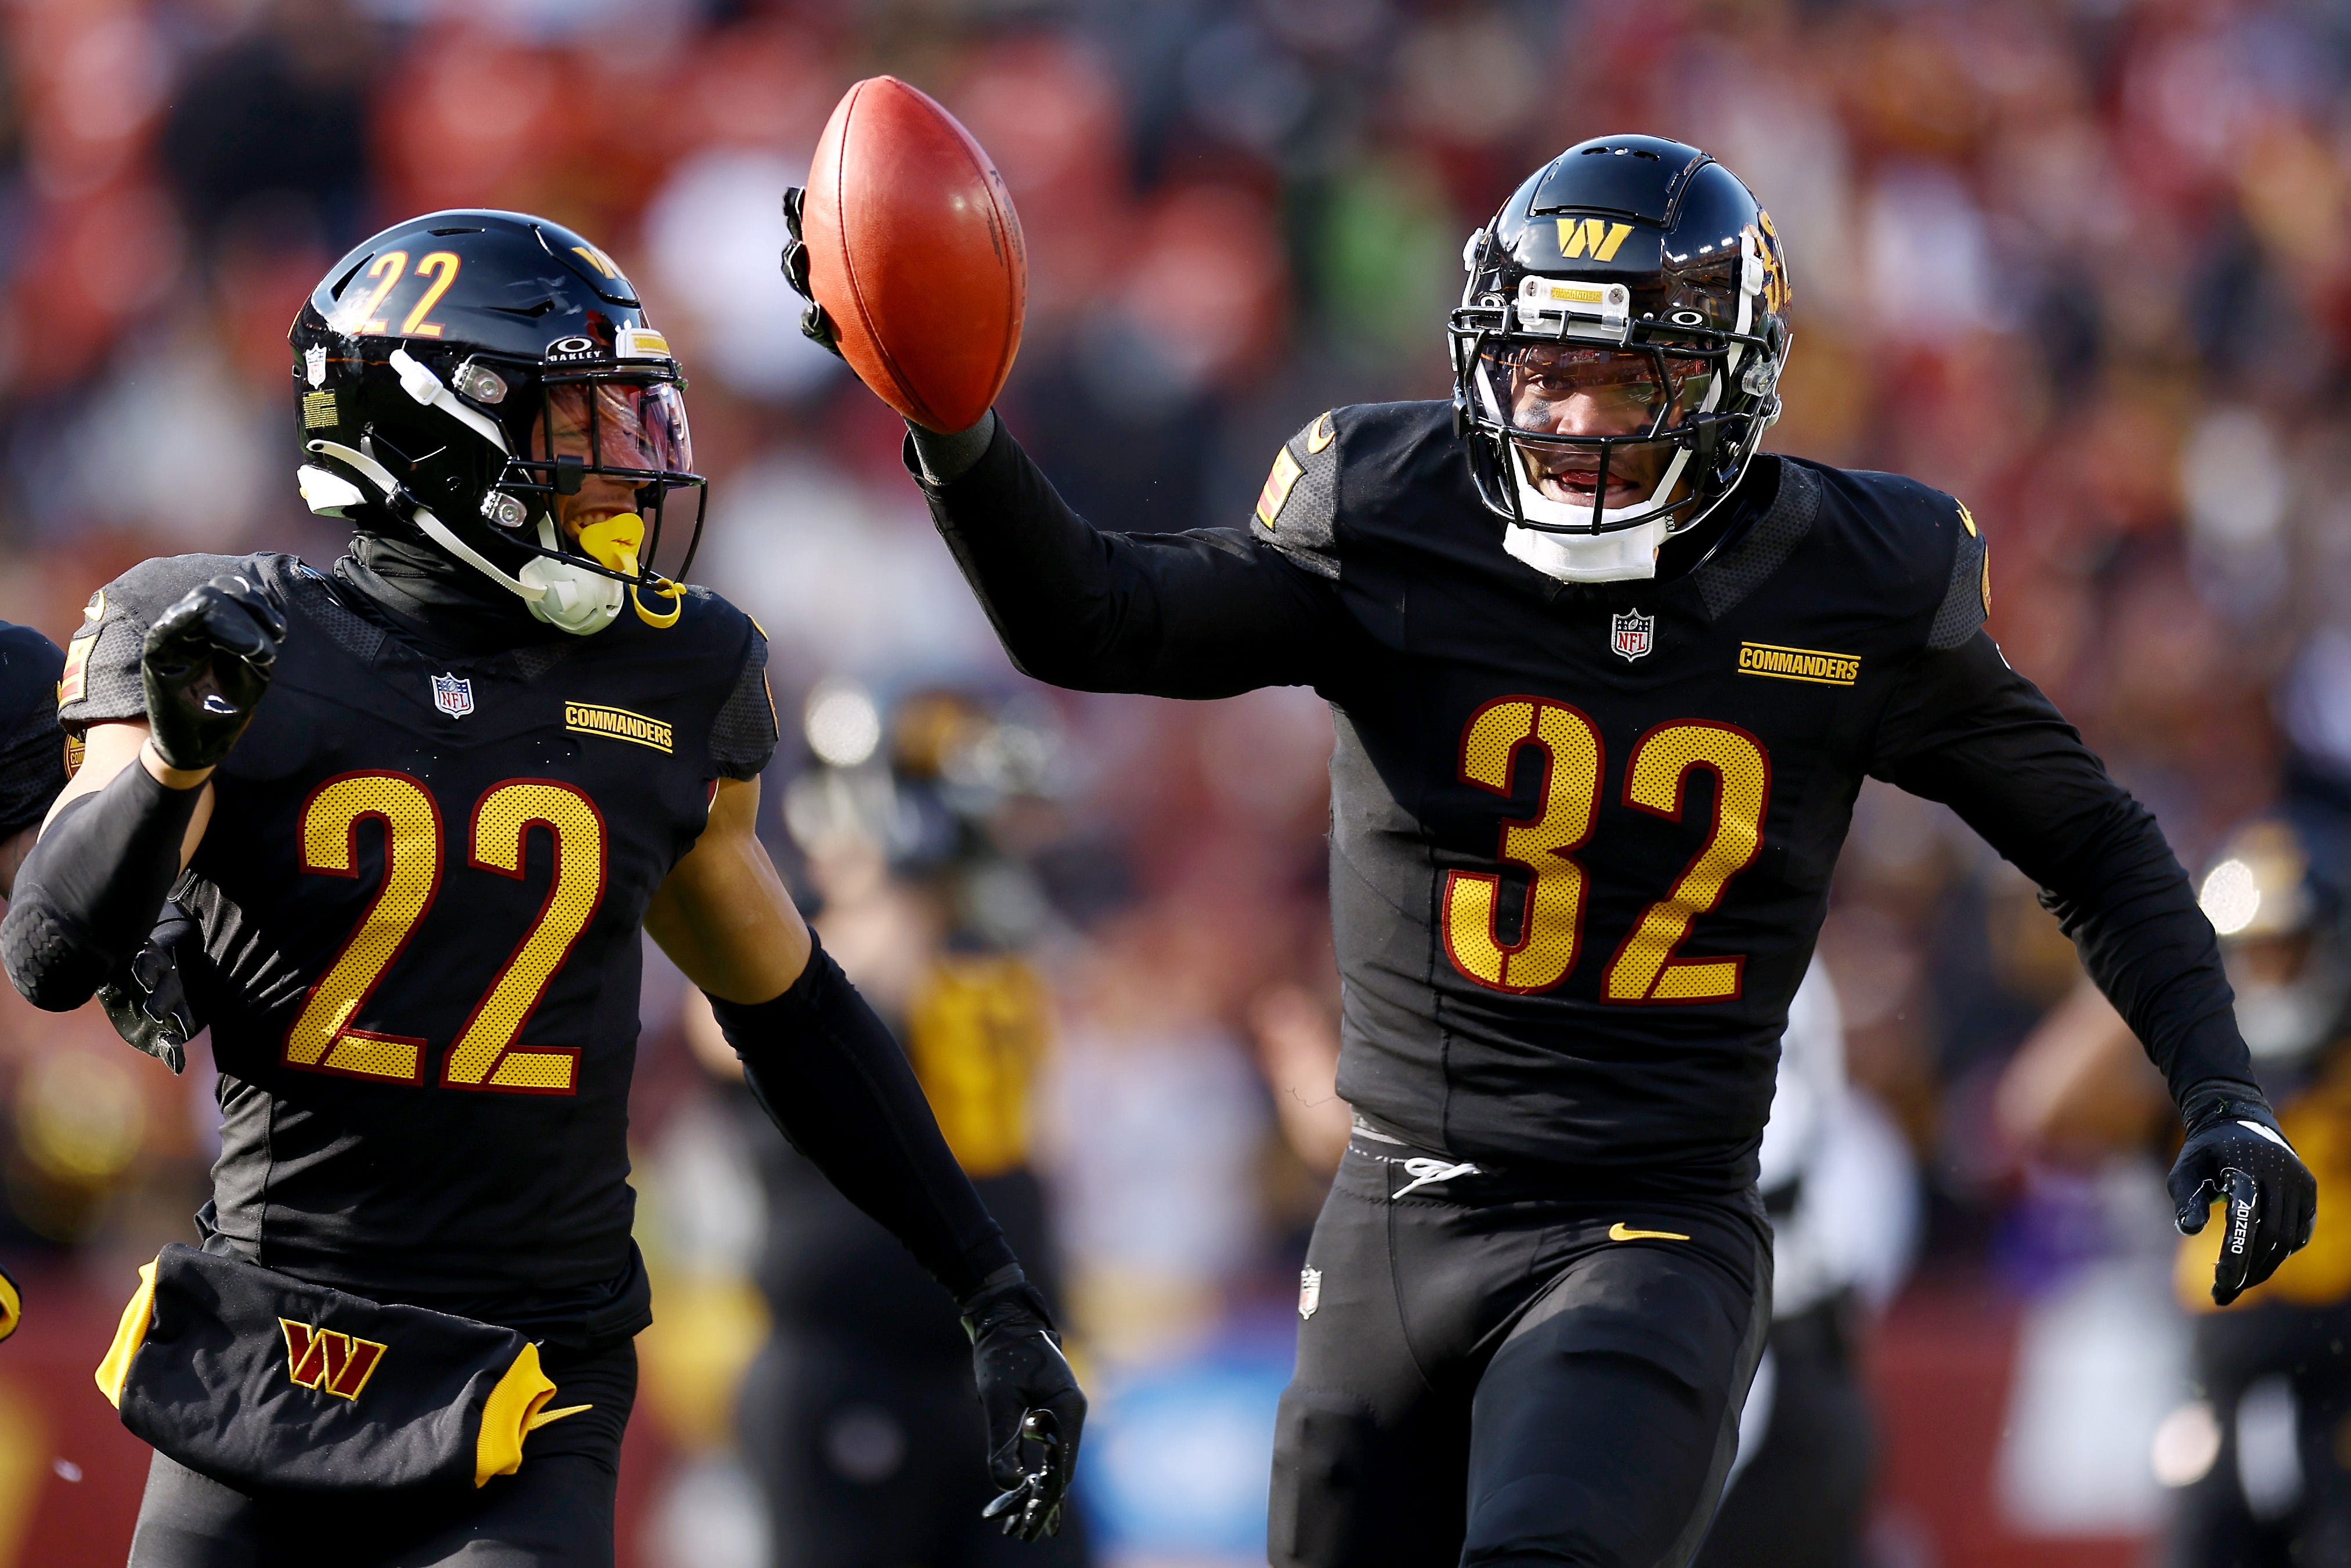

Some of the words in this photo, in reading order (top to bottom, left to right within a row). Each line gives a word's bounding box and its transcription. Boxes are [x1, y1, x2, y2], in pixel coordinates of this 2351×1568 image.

[1557, 218, 1635, 263] W
[351, 250, 462, 341] 22
[1551, 287, 1603, 302] COMMANDERS
[548, 351, 601, 362] OAKLEY
[1618, 632, 1646, 652] NFL
[1739, 648, 1859, 680] COMMANDERS
[441, 692, 468, 709] NFL
[565, 706, 673, 747] COMMANDERS
[1442, 694, 1771, 1006] 32
[280, 769, 608, 1096] 22
[2231, 1199, 2252, 1254] ADIZERO
[278, 1317, 389, 1401] W
